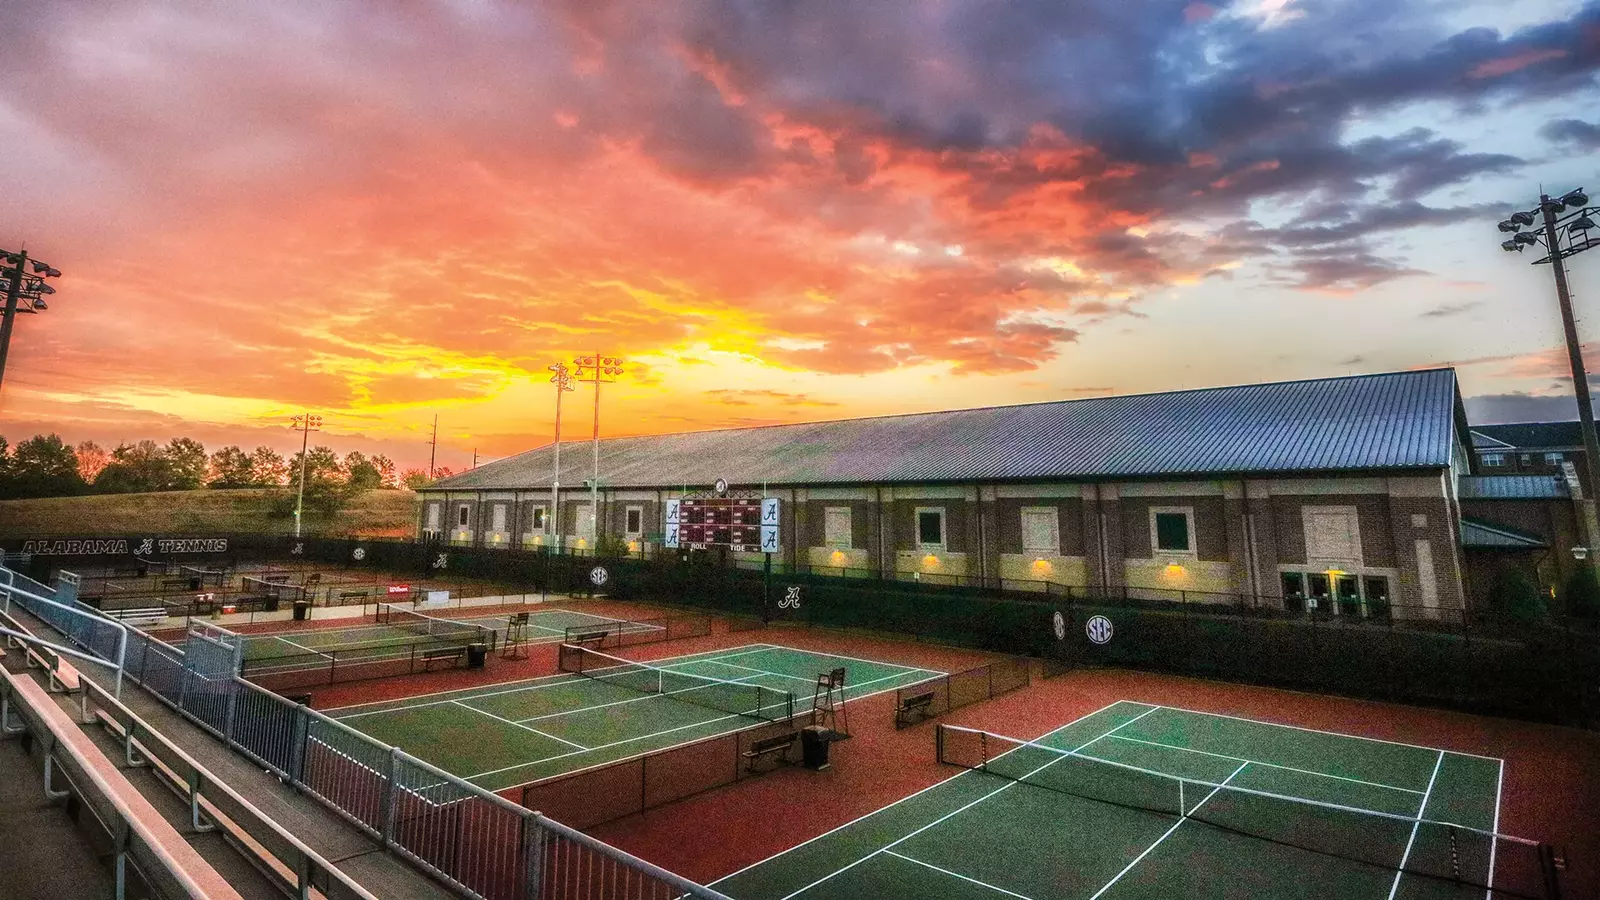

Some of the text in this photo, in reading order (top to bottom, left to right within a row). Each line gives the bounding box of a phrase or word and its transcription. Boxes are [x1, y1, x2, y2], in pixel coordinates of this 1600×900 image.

[668, 504, 678, 519] A
[764, 503, 776, 520] A
[667, 529, 677, 543] A
[763, 530, 776, 548] A
[21, 540, 128, 555] ALABAMA
[158, 539, 227, 554] TENNIS
[730, 544, 746, 552] TIDE
[592, 568, 607, 583] SEC
[389, 585, 408, 593] Wilson
[778, 587, 801, 609] A
[1089, 617, 1111, 642] SEC
